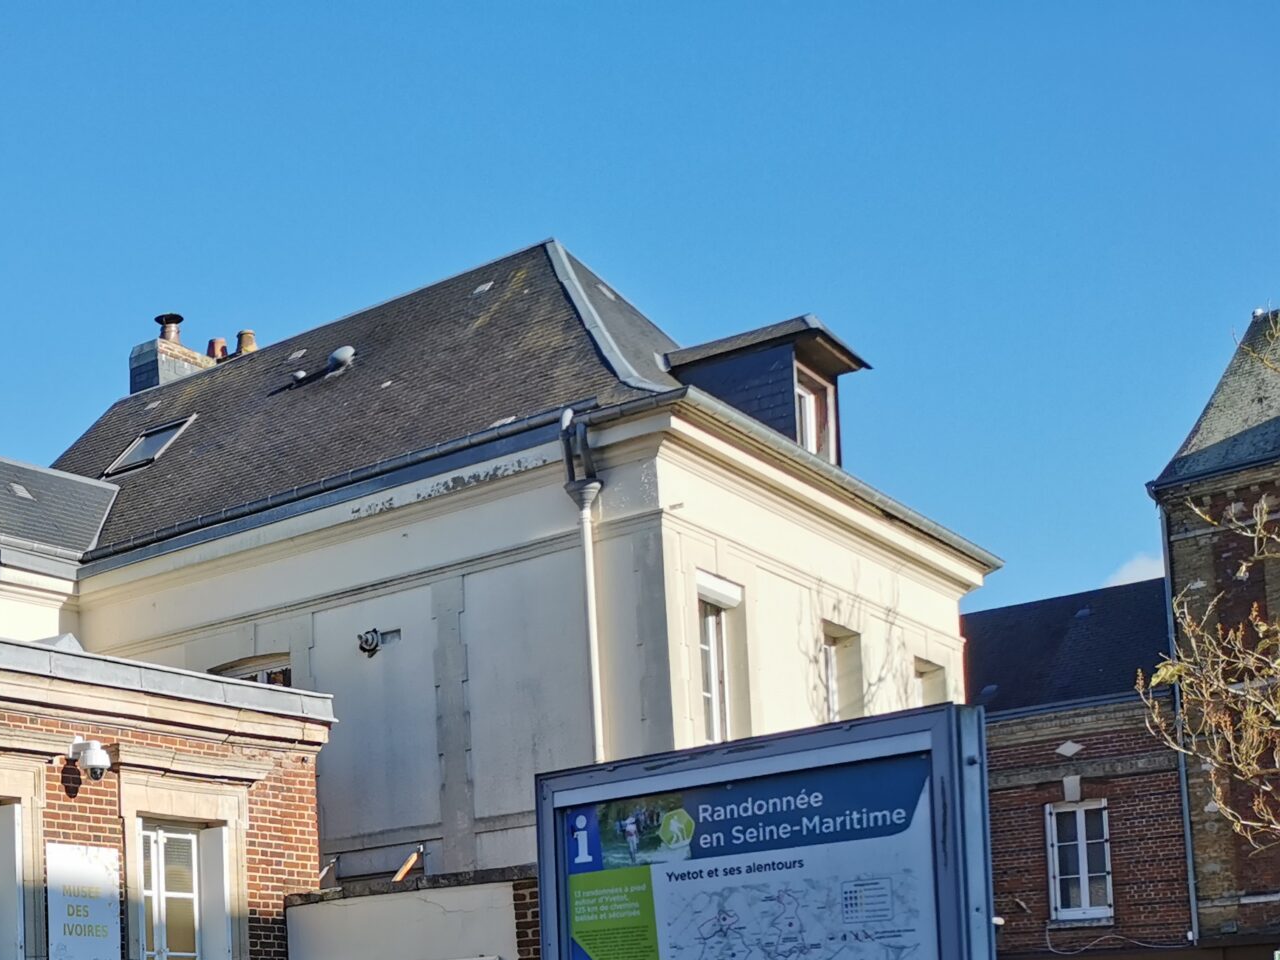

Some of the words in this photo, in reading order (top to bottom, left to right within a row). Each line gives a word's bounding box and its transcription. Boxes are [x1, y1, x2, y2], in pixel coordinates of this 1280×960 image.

[698, 789, 824, 823] Randonnée
[699, 831, 725, 849] en
[731, 807, 907, 845] Seine-Maritime
[666, 868, 705, 883] Yvetot
[707, 867, 719, 878] et
[723, 865, 743, 876] ses
[745, 859, 805, 874] alentours
[67, 903, 90, 918] DES
[63, 923, 109, 938] IVOIRES
